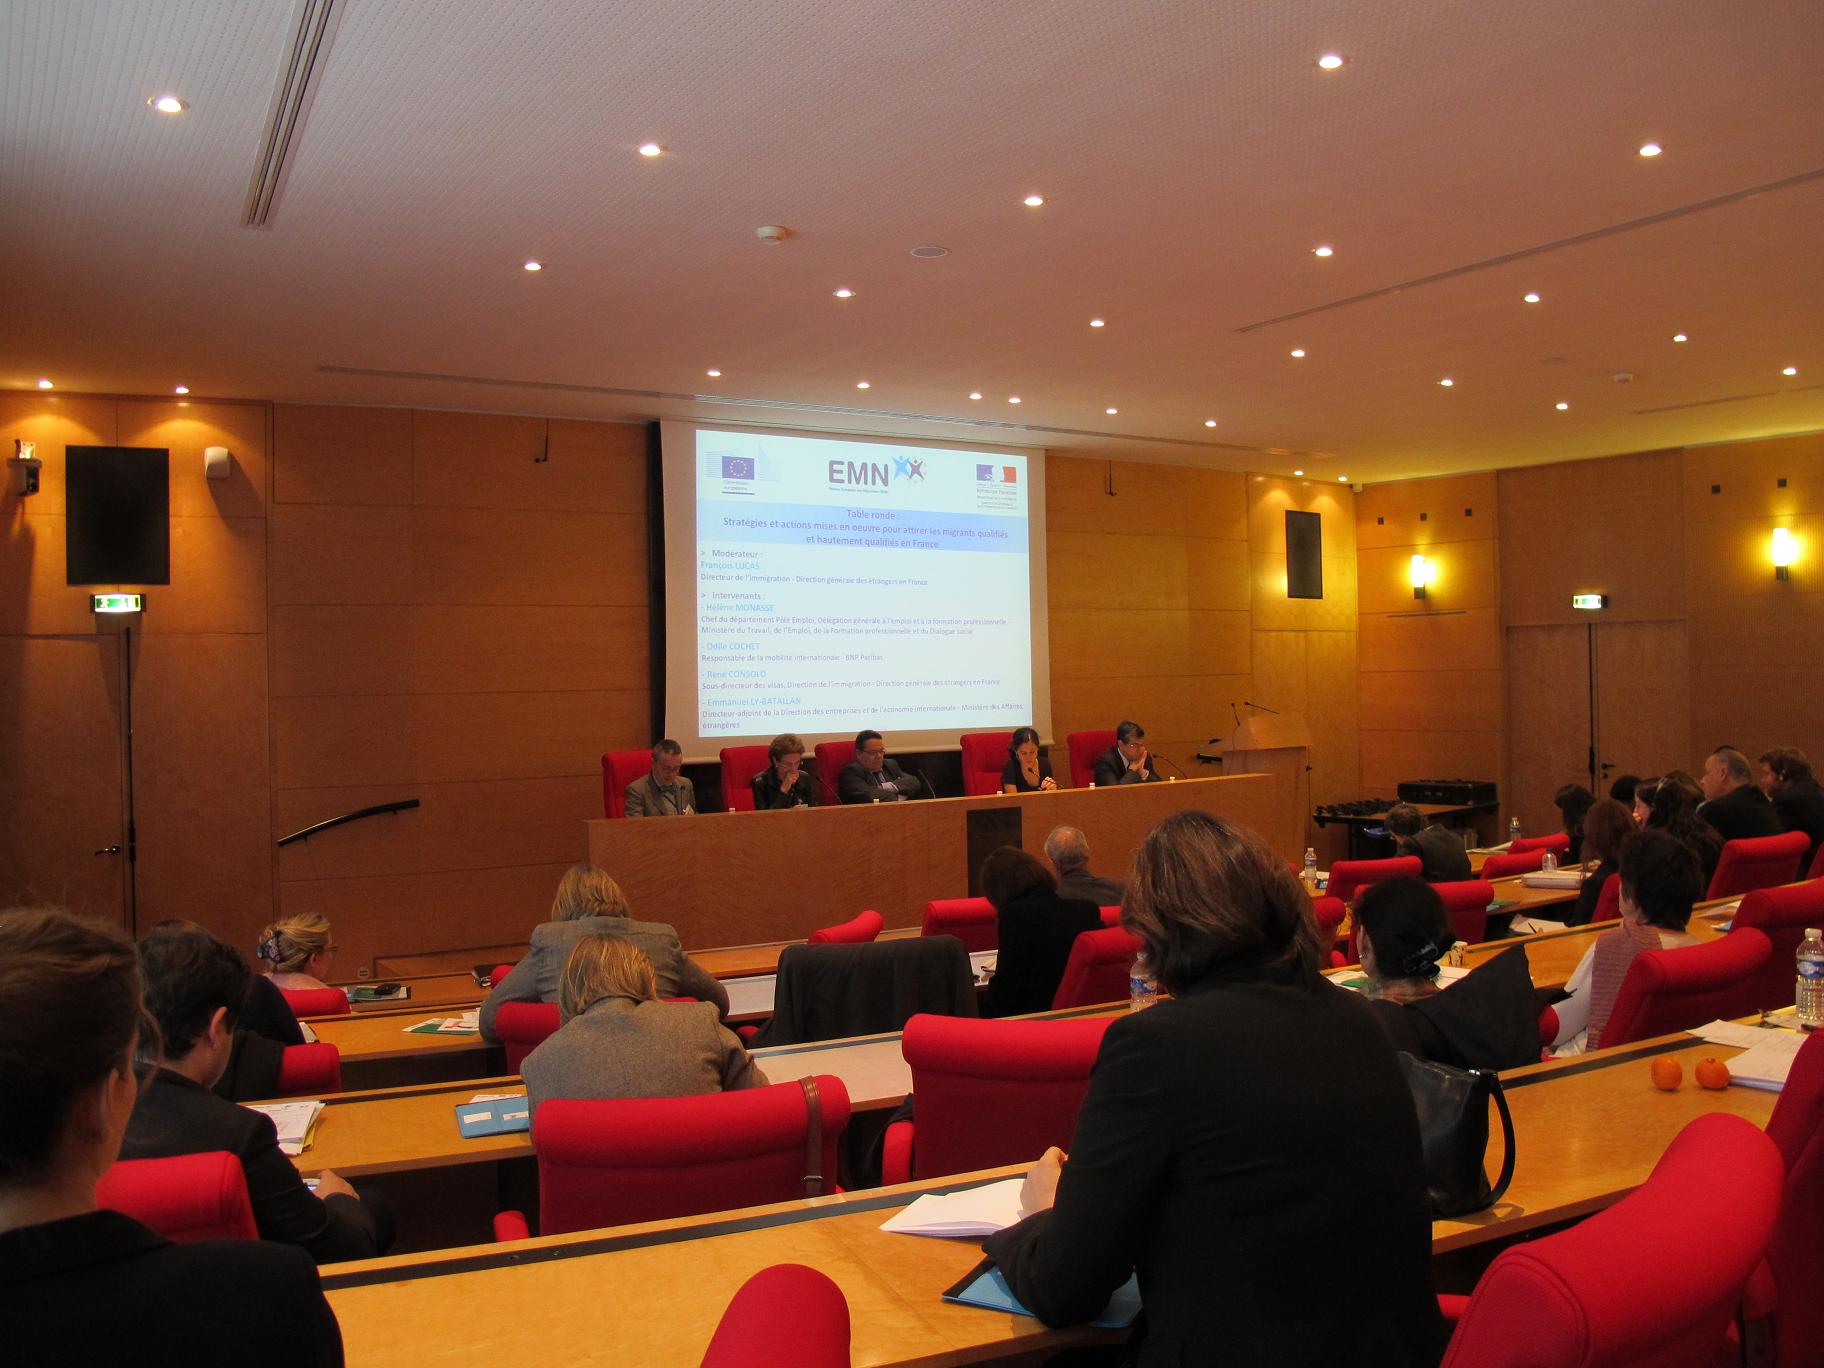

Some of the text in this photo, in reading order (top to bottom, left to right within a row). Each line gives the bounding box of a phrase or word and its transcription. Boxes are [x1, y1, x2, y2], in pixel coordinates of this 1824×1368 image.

[828, 460, 888, 487] EMN
[847, 510, 869, 519] Table
[871, 512, 895, 520] ronde
[723, 517, 767, 528] Stratégies
[770, 519, 779, 528] et
[781, 520, 811, 529] actions
[814, 522, 837, 530] mises
[882, 526, 902, 536] pour
[903, 526, 928, 535] attirer
[930, 527, 941, 536] les
[943, 528, 976, 538] migrants
[978, 529, 1008, 538] qualifiés
[817, 536, 863, 545] hautement
[865, 538, 898, 547] qualifiés
[913, 540, 939, 548] France
[700, 561, 733, 571] François
[827, 576, 854, 584] générale
[730, 616, 774, 625] département
[818, 617, 851, 625] Délégation
[750, 697, 801, 705] LY-BATALLAN
[702, 710, 761, 718] Directeur-adjoint
[702, 721, 740, 729] étrangères
